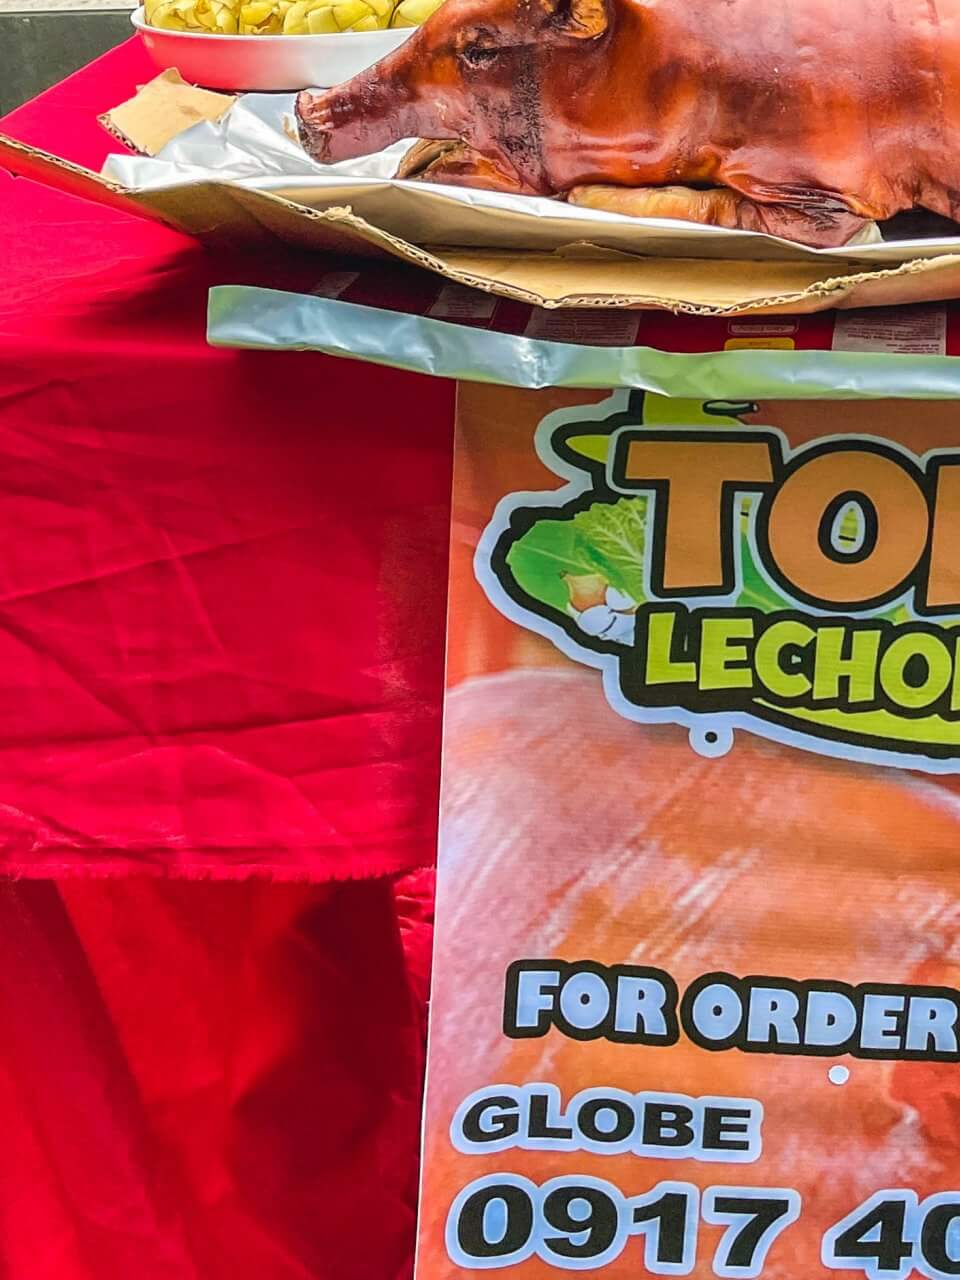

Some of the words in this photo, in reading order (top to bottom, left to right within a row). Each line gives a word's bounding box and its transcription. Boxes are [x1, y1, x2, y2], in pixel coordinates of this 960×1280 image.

[515, 970, 669, 1036] FOR
[693, 983, 958, 1053] ORDER
[463, 1094, 752, 1151] GLOBE
[457, 1183, 788, 1267] 0917
